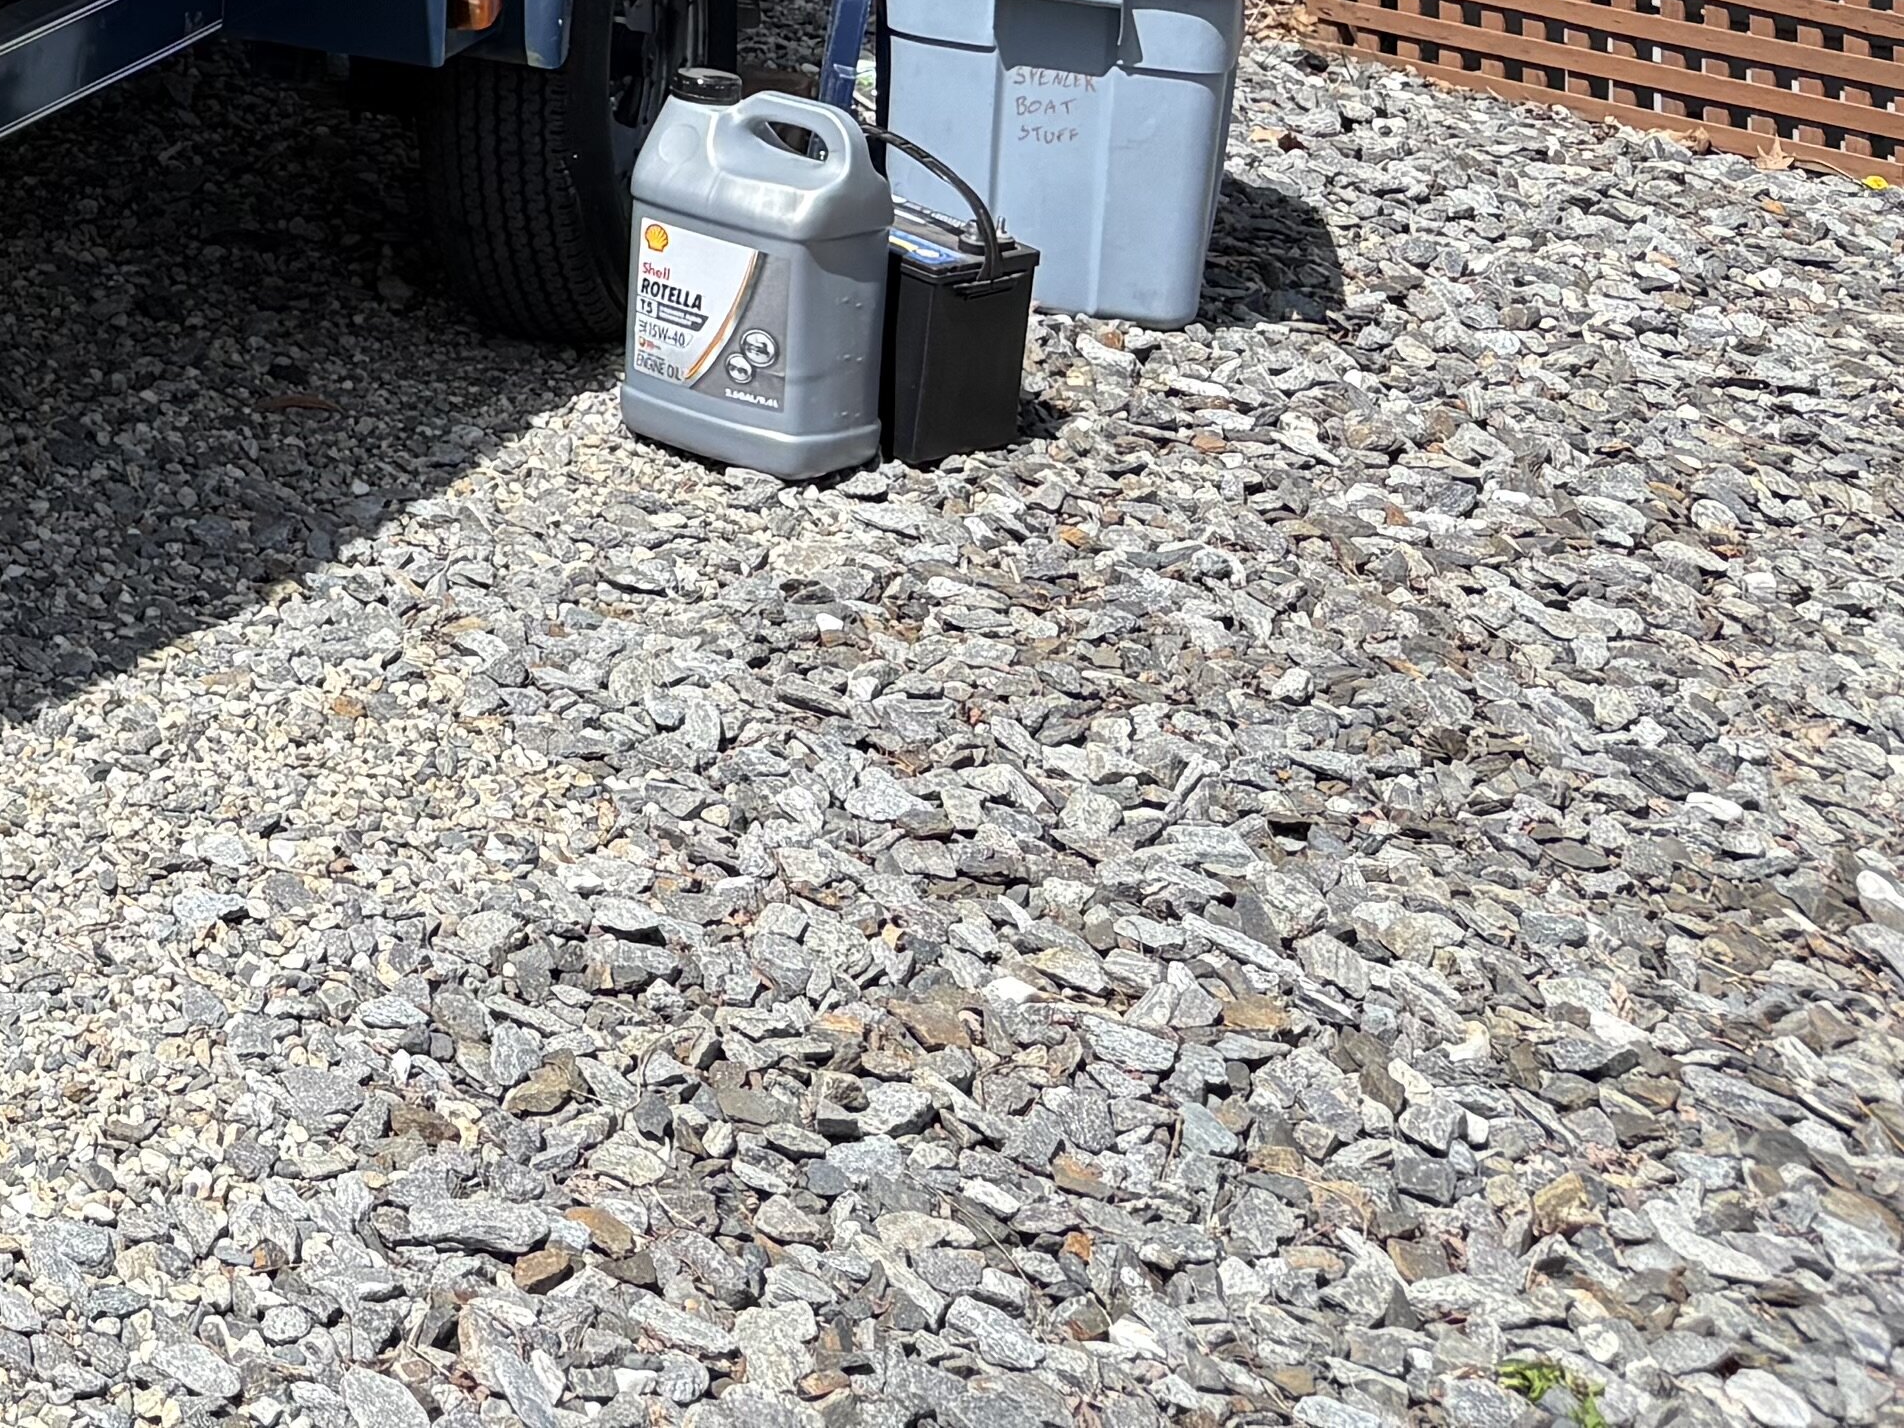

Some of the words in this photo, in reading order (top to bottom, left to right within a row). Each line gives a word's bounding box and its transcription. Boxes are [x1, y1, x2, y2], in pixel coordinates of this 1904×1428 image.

[1016, 96, 1077, 116] BOAT
[1018, 125, 1079, 144] STUFF
[642, 262, 671, 281] Shell
[641, 277, 703, 312] ROTELLA
[648, 323, 686, 346] 15W-40
